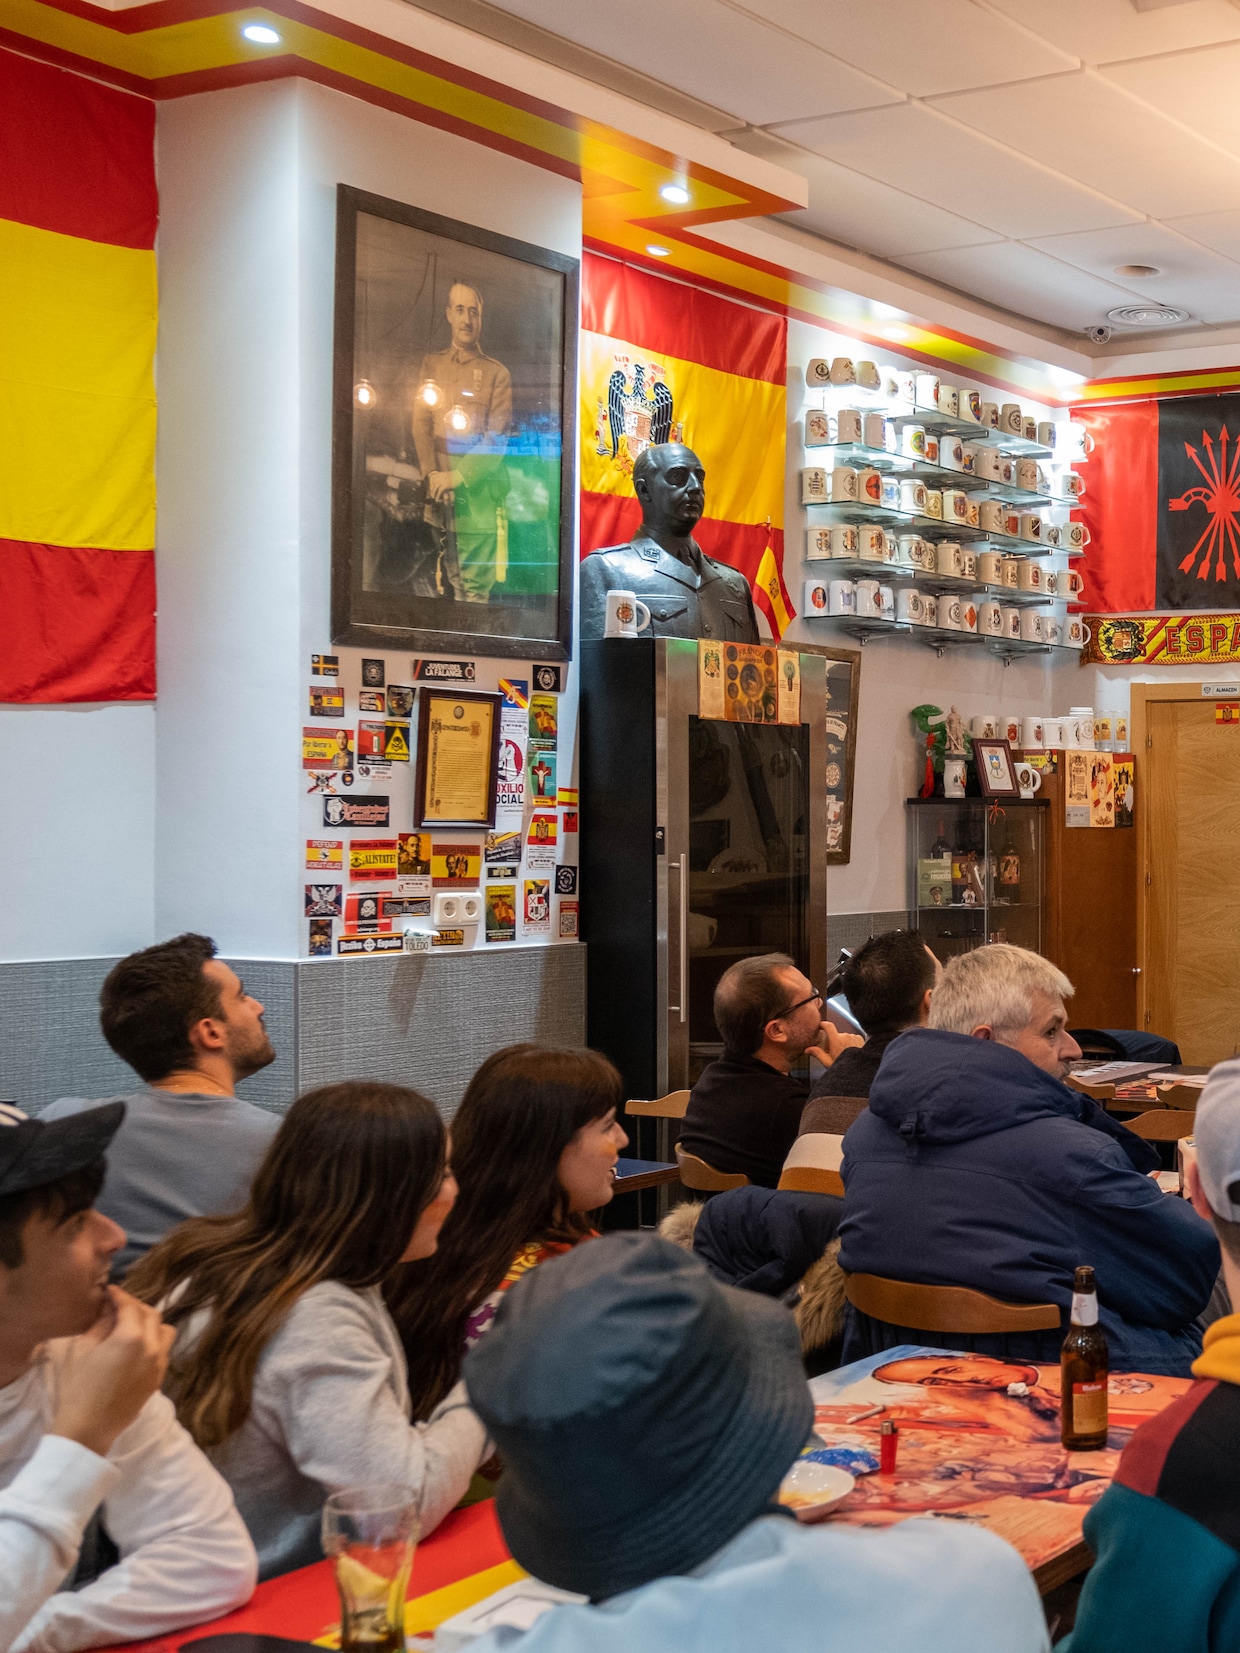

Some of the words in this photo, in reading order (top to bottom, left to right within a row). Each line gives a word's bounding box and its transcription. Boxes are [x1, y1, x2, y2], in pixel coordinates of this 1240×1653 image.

[434, 669, 463, 678] FALANGE
[496, 783, 524, 793] UXILIO
[496, 794, 524, 804] OCIAL
[404, 941, 429, 951] TOLEDO
